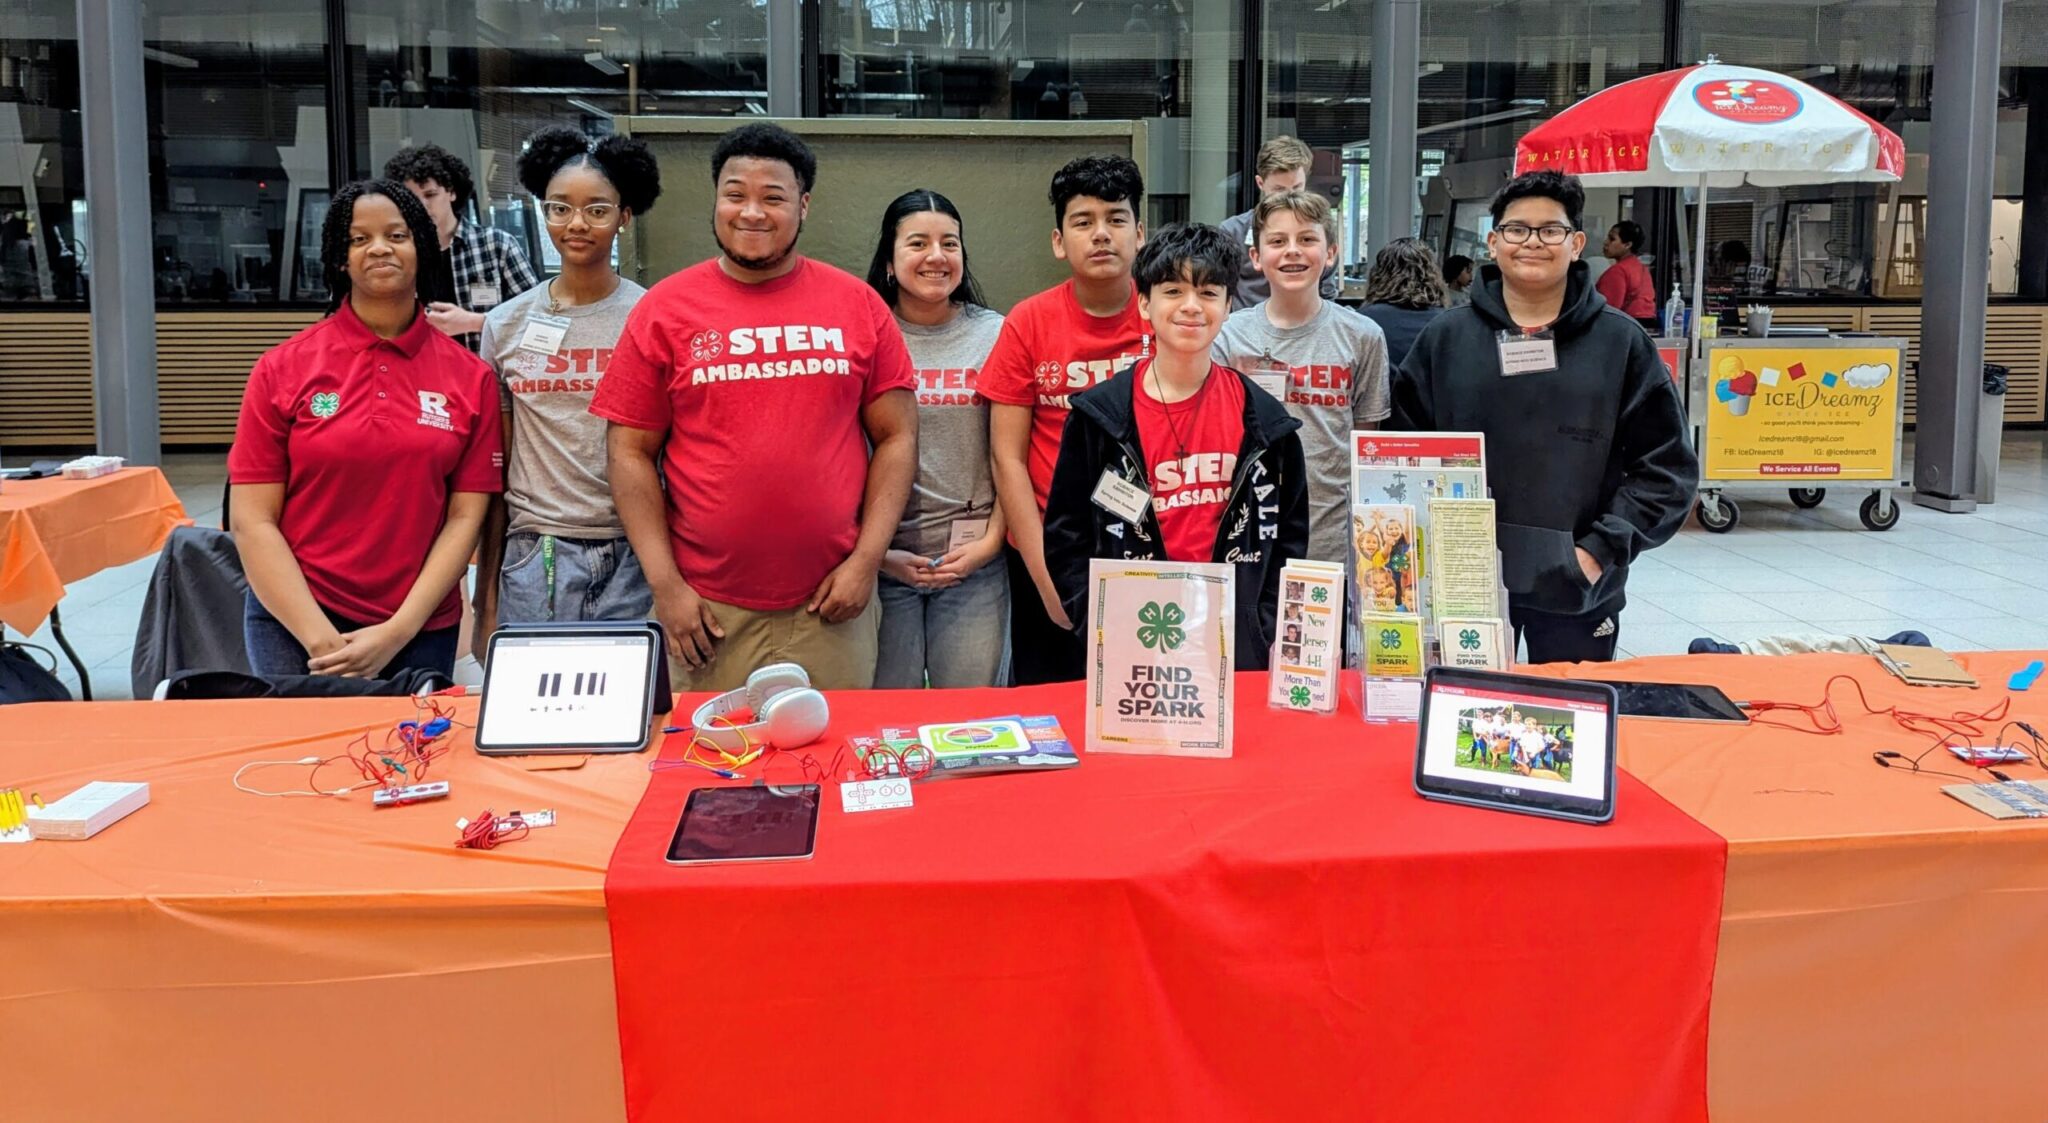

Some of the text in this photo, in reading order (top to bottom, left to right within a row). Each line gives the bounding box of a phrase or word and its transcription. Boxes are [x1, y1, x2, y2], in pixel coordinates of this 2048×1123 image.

[1527, 145, 1641, 163] WATER ICE
[1668, 142, 1854, 154] WATER ICE
[729, 325, 846, 356] STEM
[544, 348, 614, 374] STE
[691, 357, 850, 386] AMBASSADOR
[1289, 365, 1353, 390] TEM
[511, 379, 600, 393] AMBASS
[418, 390, 450, 418] R
[1289, 391, 1349, 407] SSADO
[417, 418, 454, 431] UNIVERSITY
[1814, 465, 1838, 473] Events
[1225, 546, 1262, 563] Coast
[1307, 614, 1326, 627] New
[1302, 633, 1328, 651] Jersey
[1305, 654, 1322, 667] 4-H
[1376, 658, 1409, 666] SPARK
[1456, 658, 1489, 666] SPARK
[1131, 665, 1192, 683] FIND
[1284, 674, 1321, 687] More Than
[1124, 682, 1199, 700] YOUR
[1118, 698, 1205, 718] SPARK
